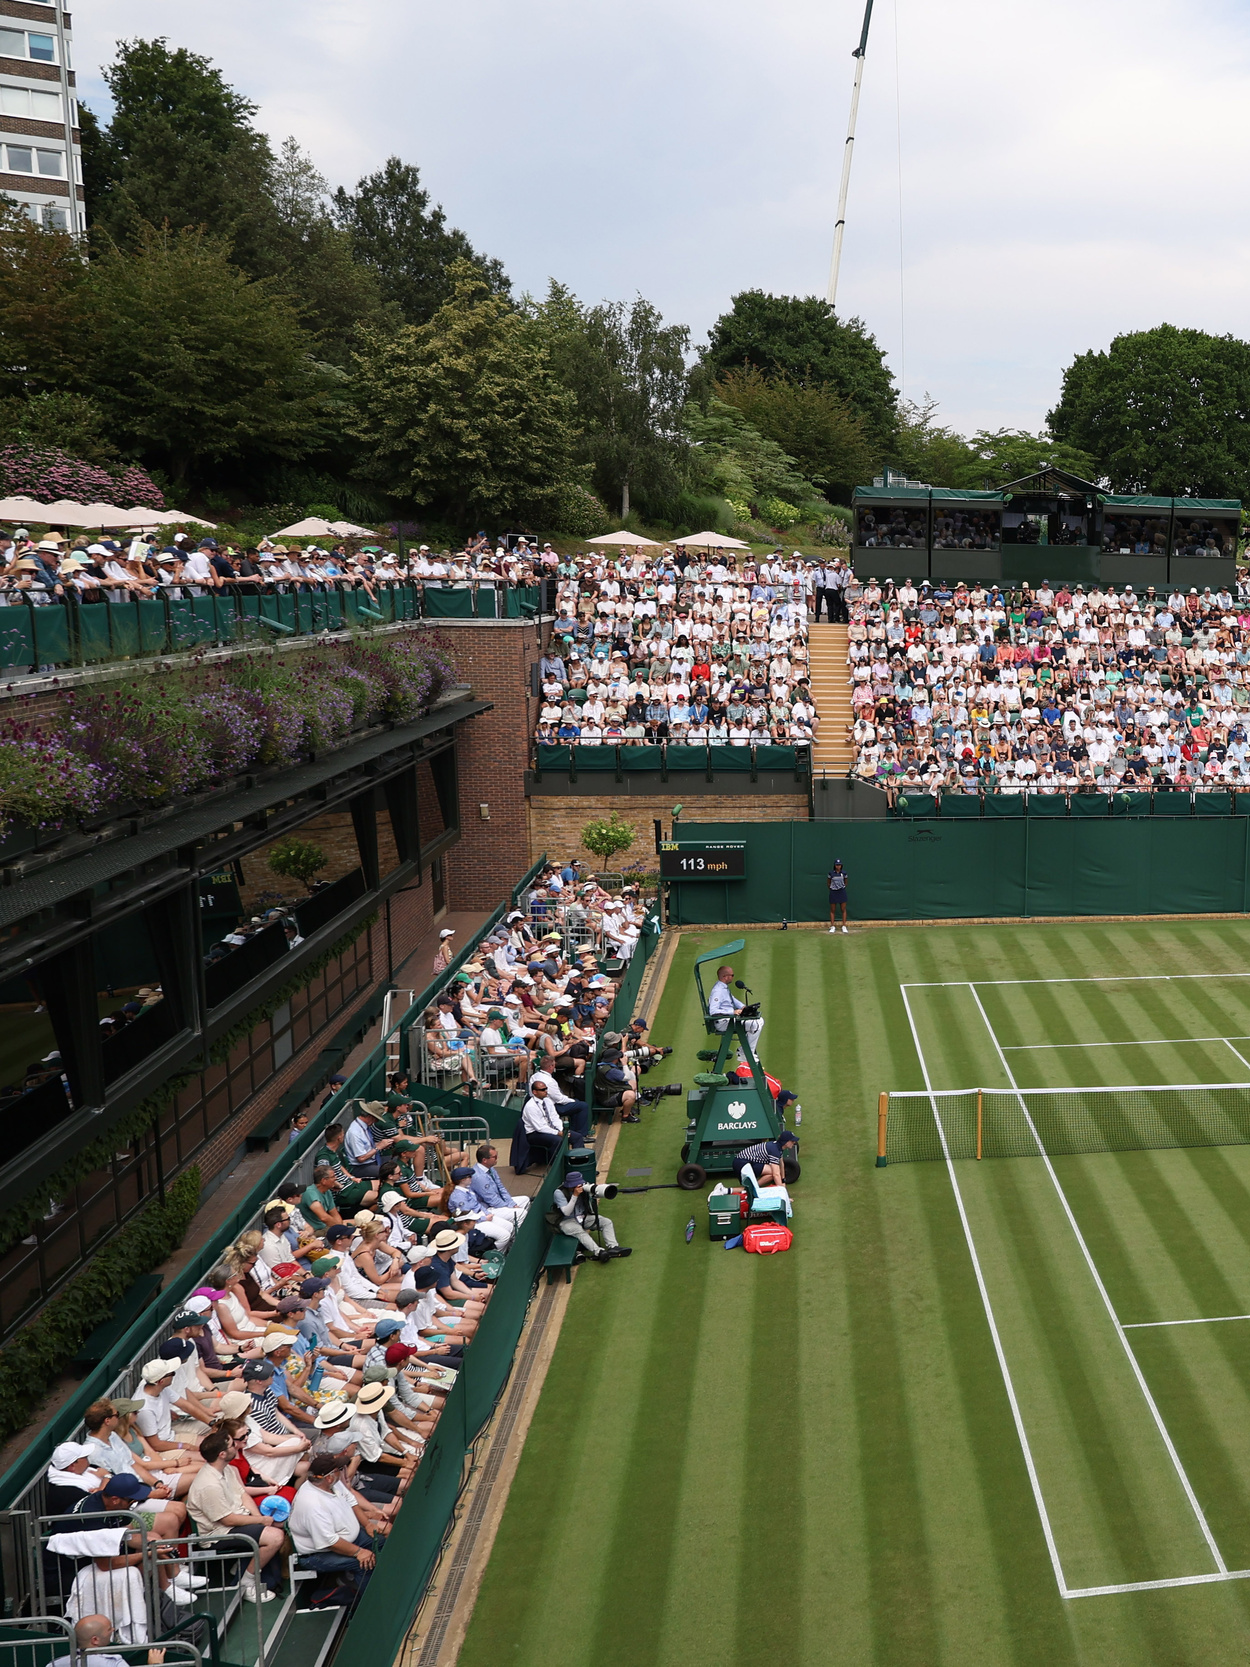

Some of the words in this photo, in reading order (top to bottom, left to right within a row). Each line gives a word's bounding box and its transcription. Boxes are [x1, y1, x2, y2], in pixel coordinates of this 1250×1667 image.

[908, 835, 942, 843] Slazenger
[661, 843, 679, 851] IBM
[680, 858, 705, 870] 113
[707, 861, 728, 872] mph
[717, 1121, 757, 1130] BARCLAYS
